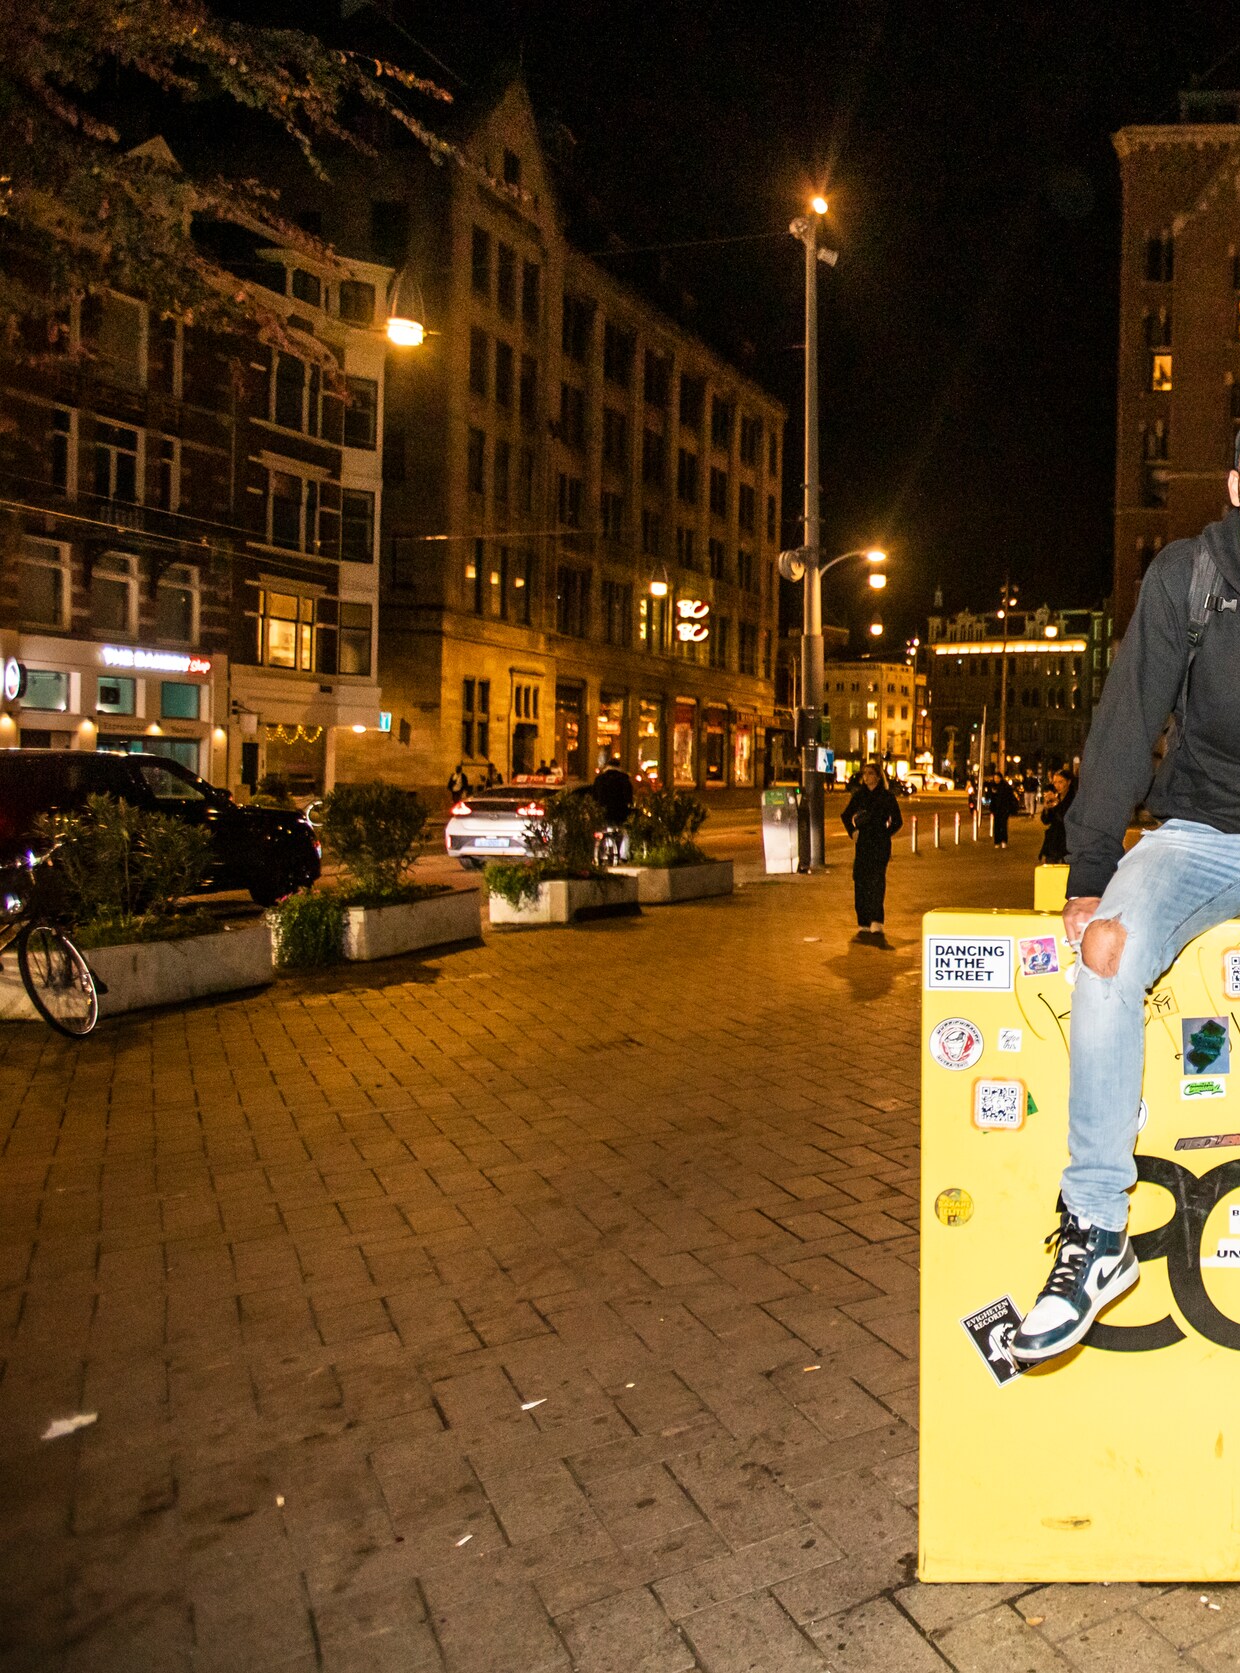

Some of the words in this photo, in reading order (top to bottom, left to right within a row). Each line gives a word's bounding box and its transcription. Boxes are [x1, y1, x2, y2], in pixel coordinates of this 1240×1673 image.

[935, 945, 1005, 957] DANCING
[935, 958, 950, 968] IN
[954, 958, 985, 969] THE
[935, 970, 994, 981] STREET
[973, 1308, 1009, 1331] RECORDS
